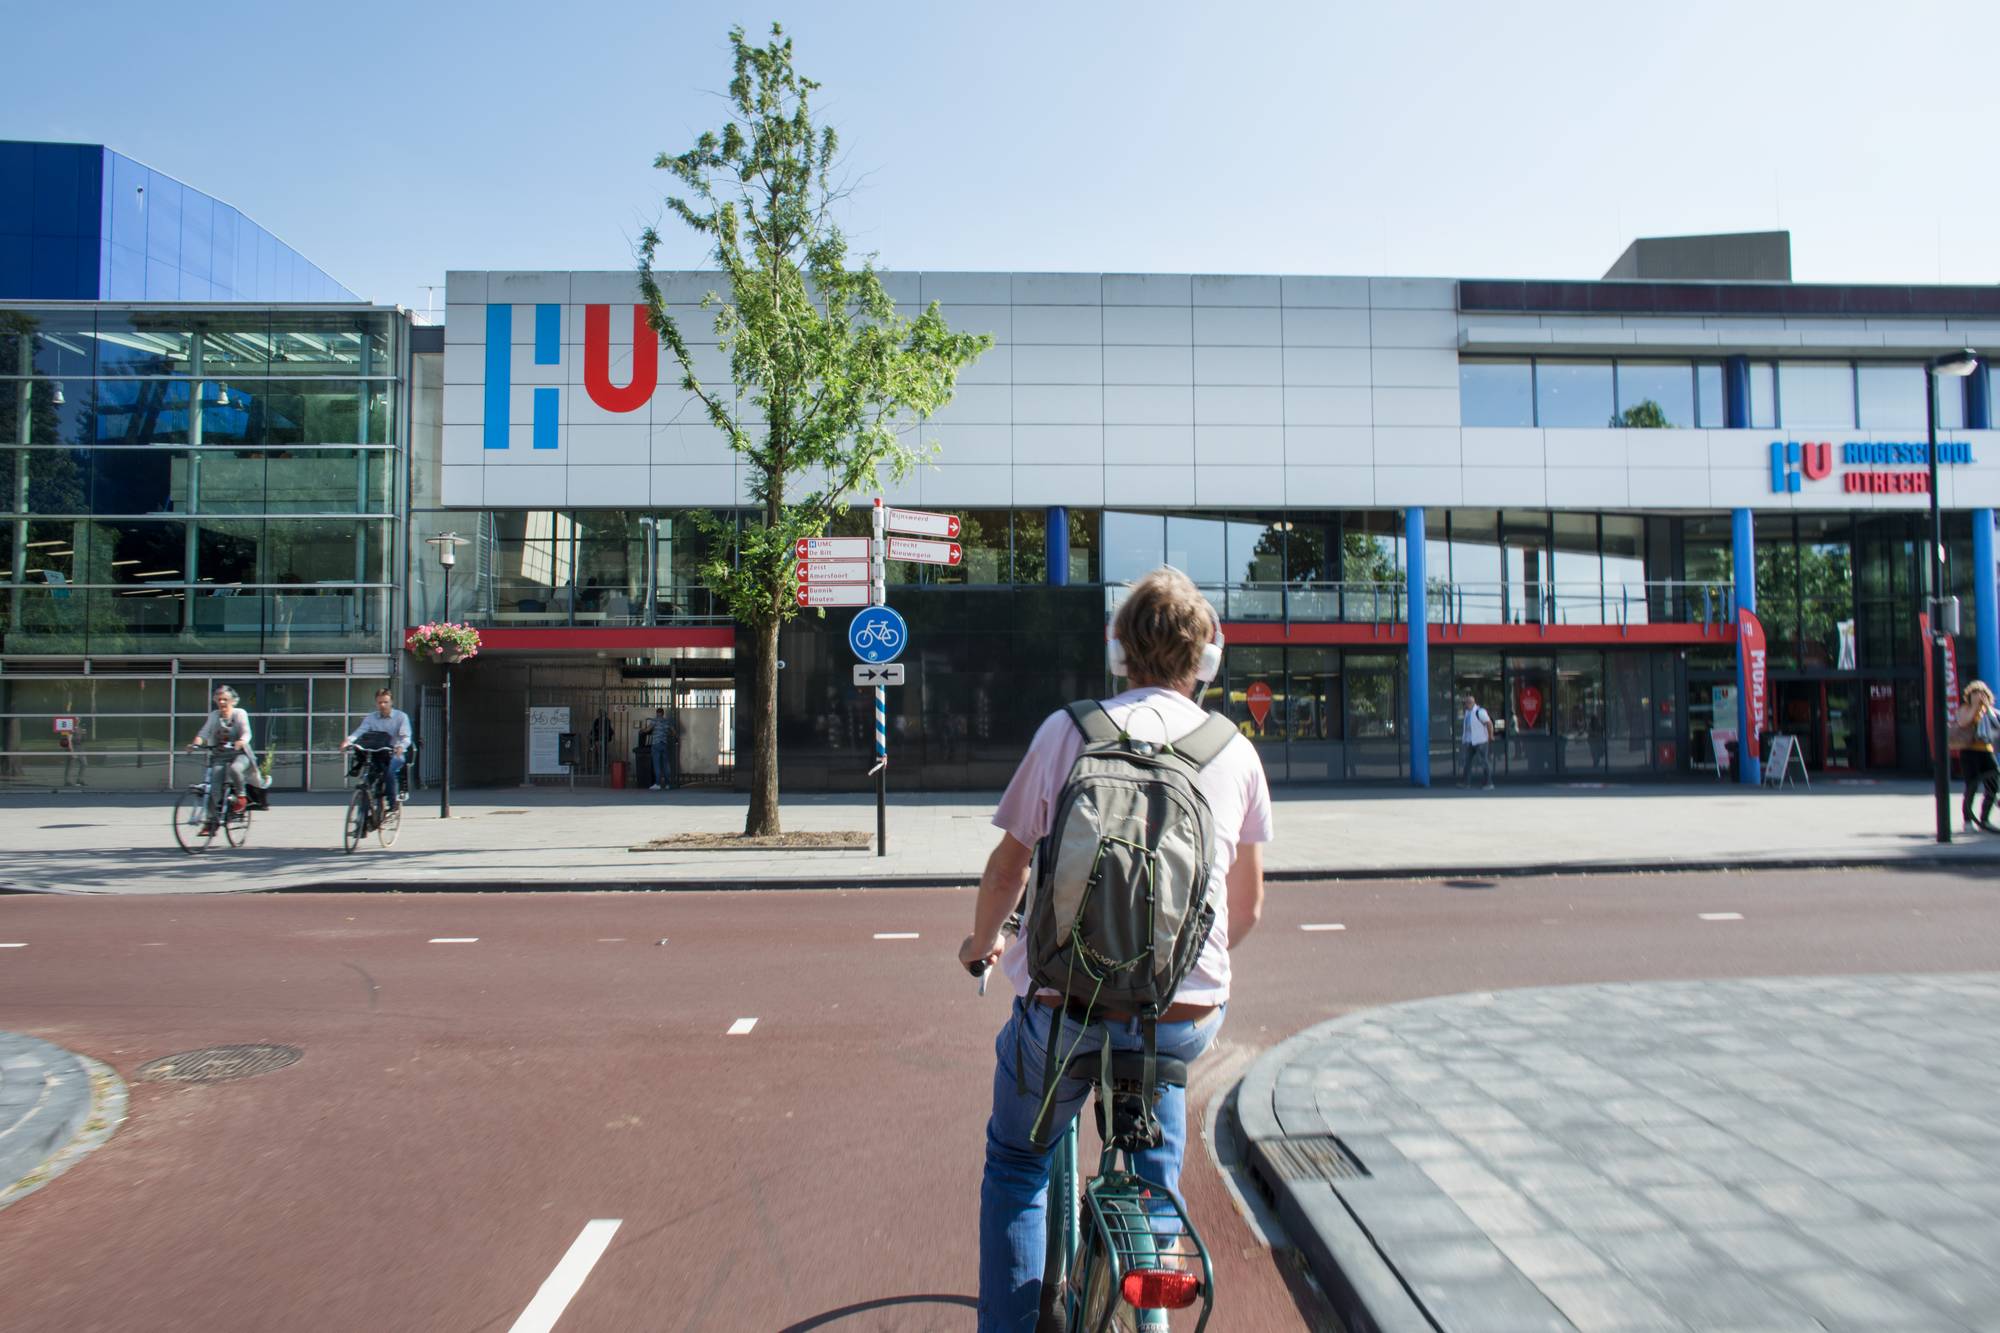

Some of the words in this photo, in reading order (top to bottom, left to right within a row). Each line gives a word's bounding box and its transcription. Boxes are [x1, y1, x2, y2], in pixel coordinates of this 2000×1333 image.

[484, 304, 658, 449] HU
[1770, 441, 1832, 493] HU
[1844, 472, 1931, 494] UTRECH
[892, 540, 918, 549] Utrecht
[891, 549, 931, 558] Nieuwegein
[809, 572, 848, 580] Amersfoort
